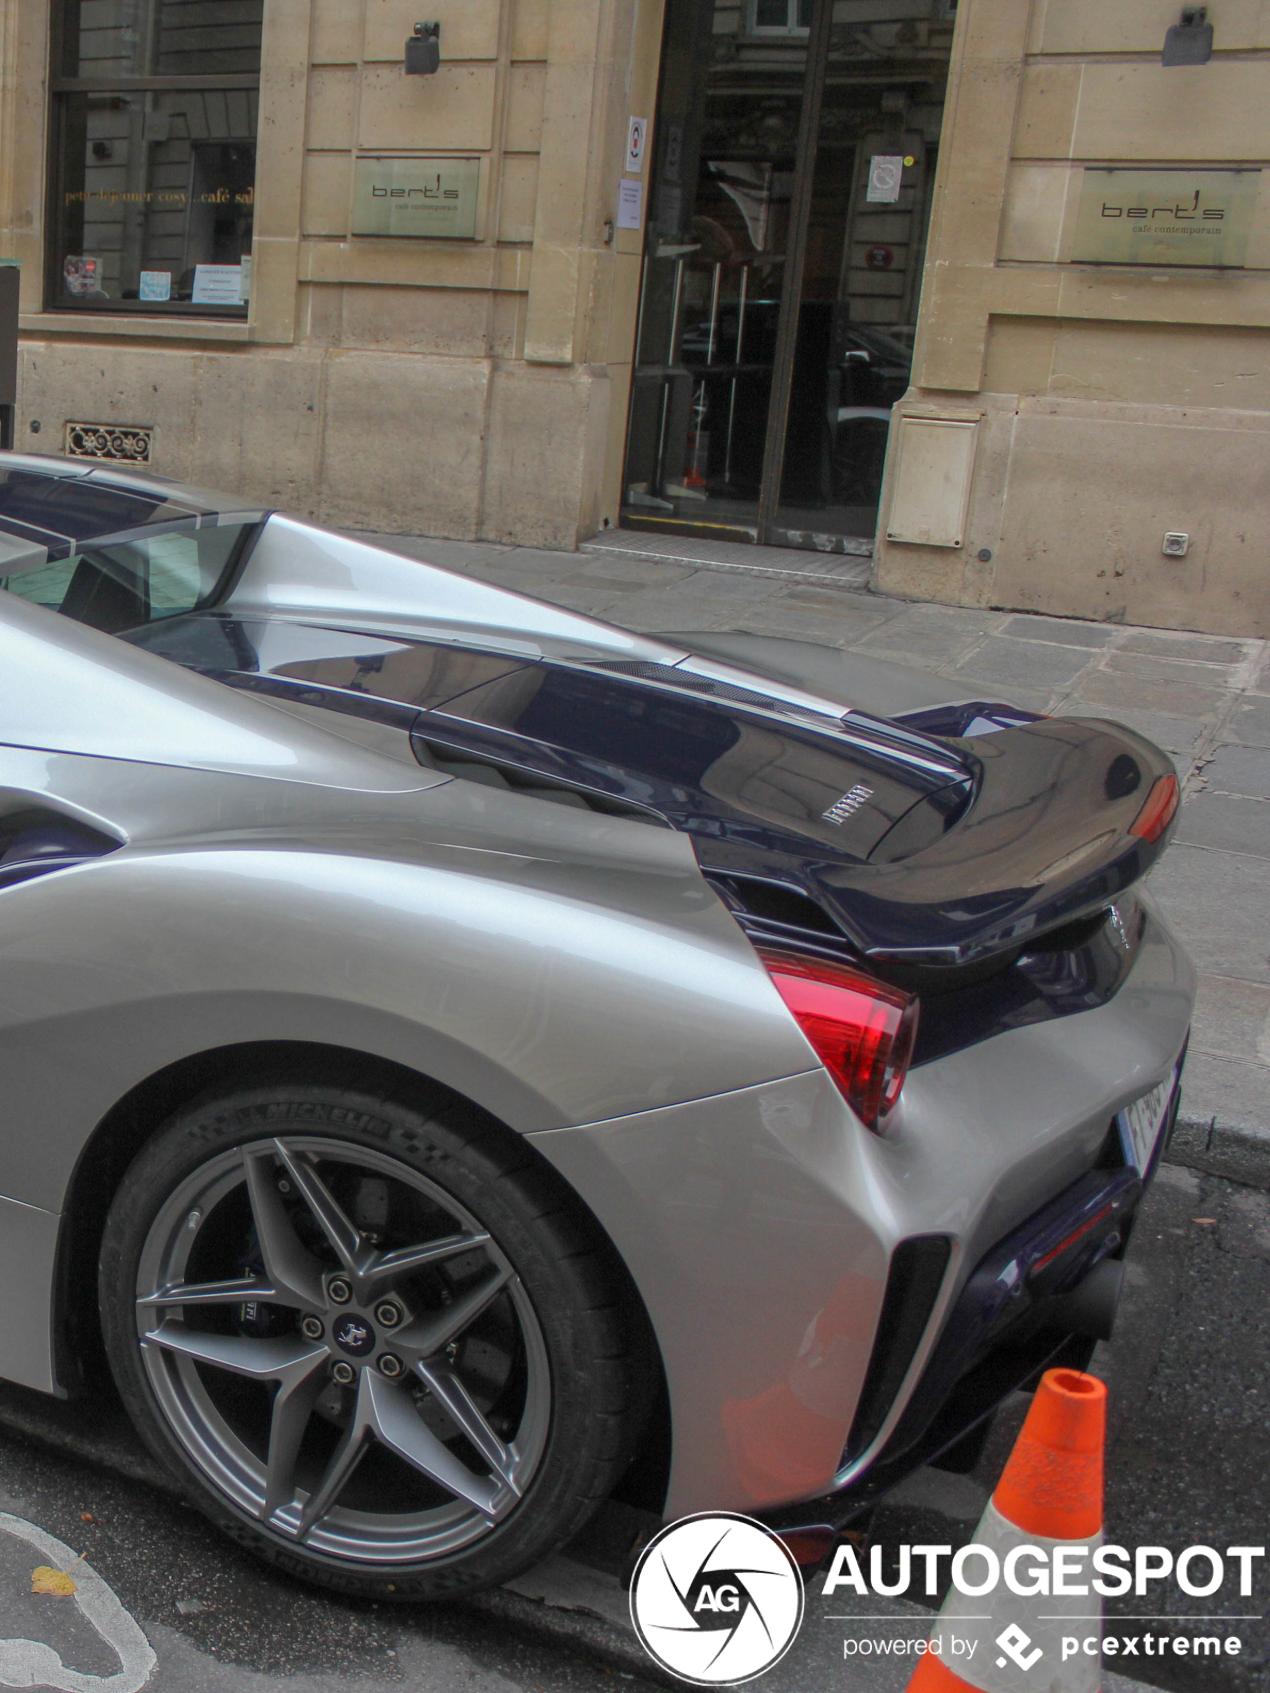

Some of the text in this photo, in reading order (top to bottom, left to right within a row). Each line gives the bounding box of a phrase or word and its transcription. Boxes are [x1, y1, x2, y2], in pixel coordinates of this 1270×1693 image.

[372, 173, 459, 199] bert's
[1101, 189, 1225, 220] bert's
[1132, 225, 1222, 236] café contemporain
[265, 1102, 393, 1140] MICHELIN
